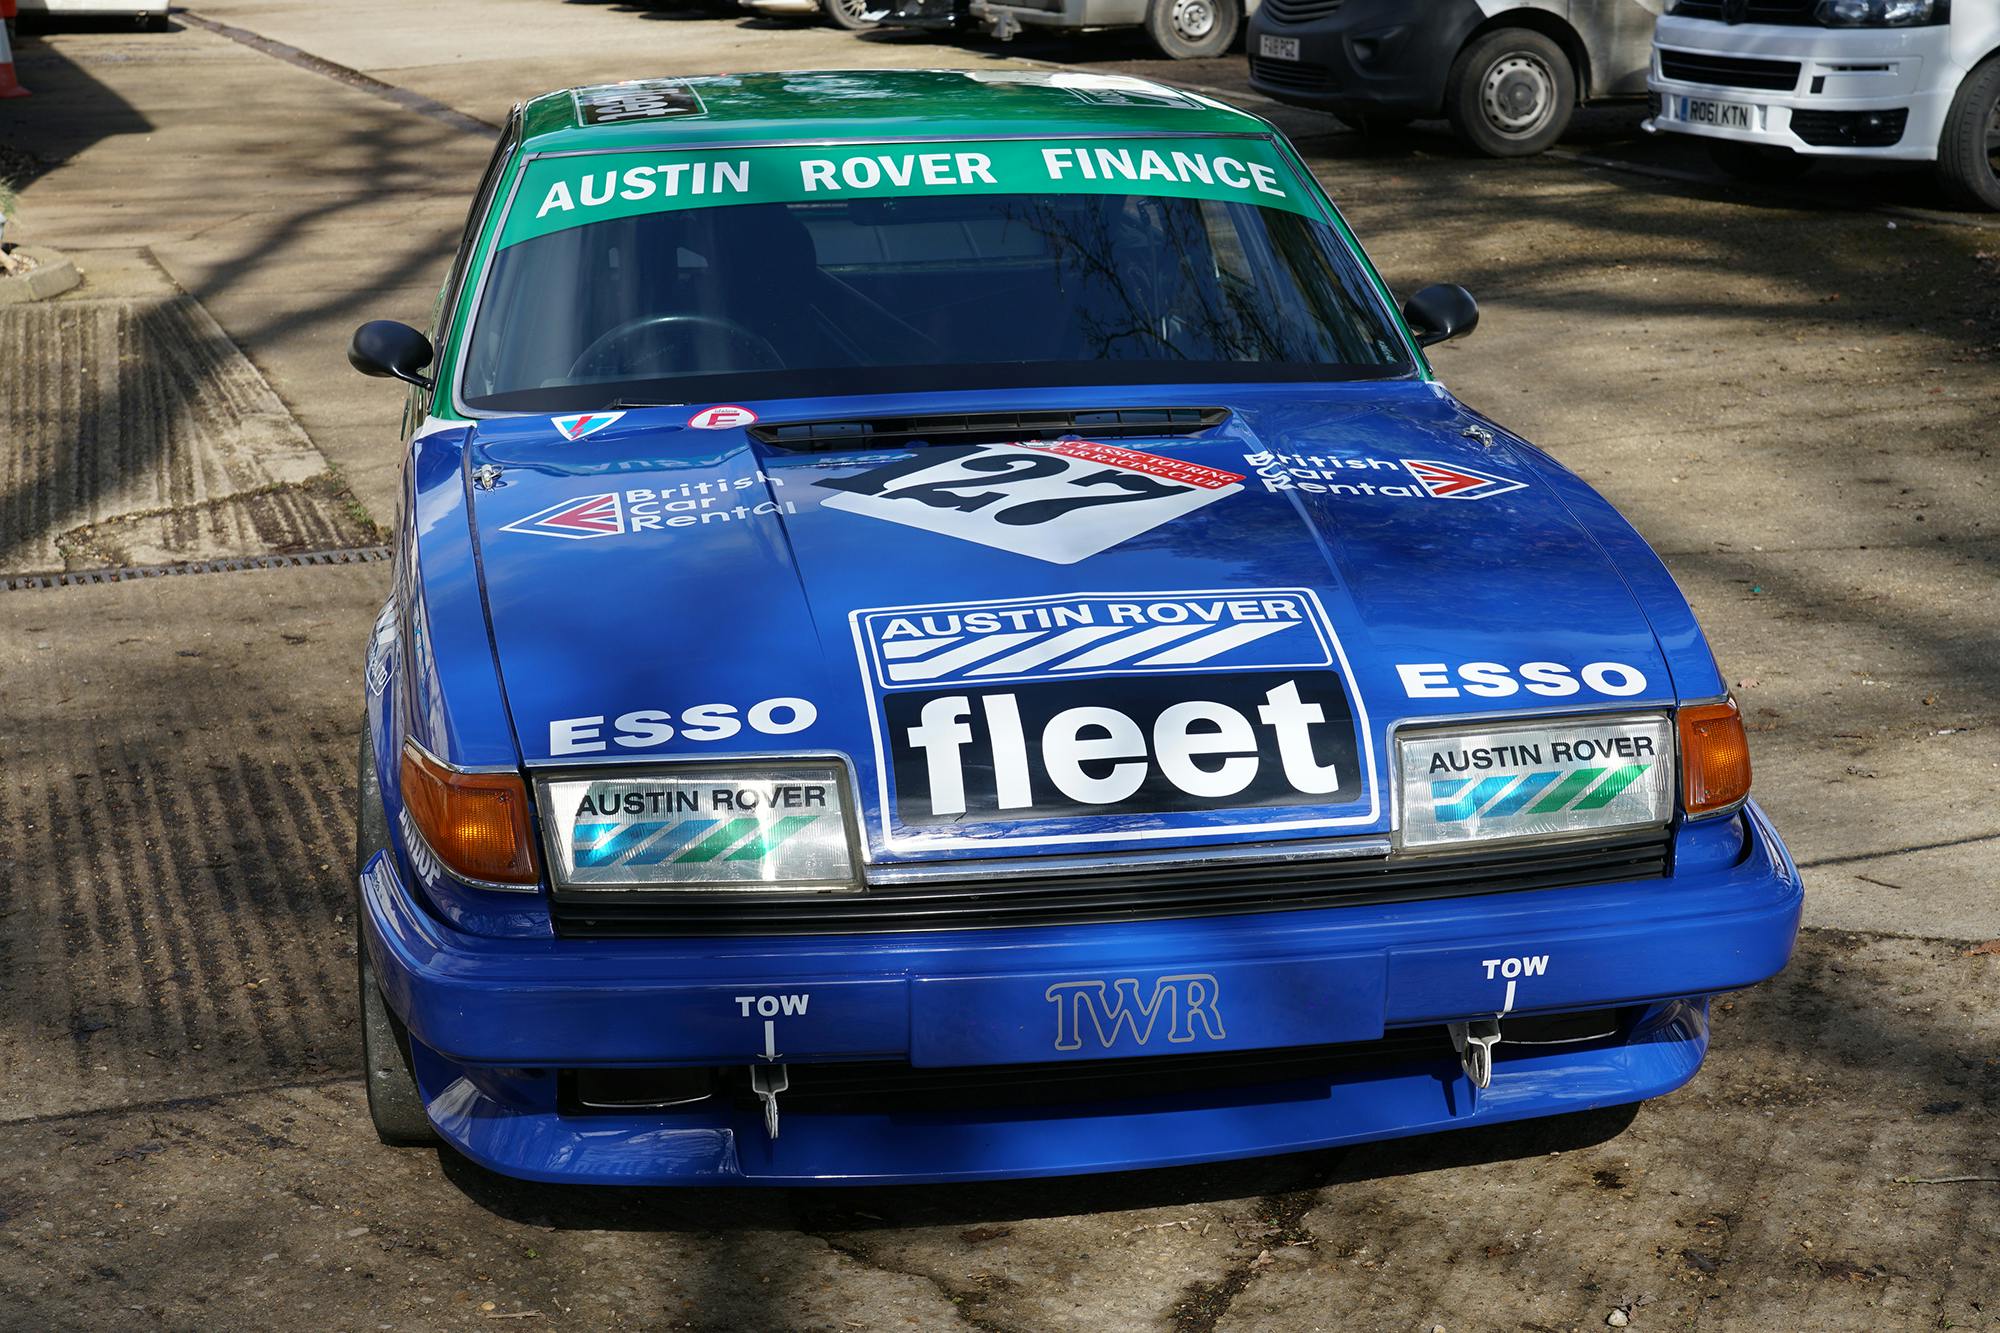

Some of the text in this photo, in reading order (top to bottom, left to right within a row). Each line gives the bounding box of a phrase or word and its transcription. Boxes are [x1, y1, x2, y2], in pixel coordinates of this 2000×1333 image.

[1722, 105, 1748, 126] KTN
[536, 148, 1286, 218] AUSTIN ROVER FINANCE
[1050, 446, 1224, 487] CAR RACING CLUB
[1062, 441, 1147, 460] CLASSIC
[1147, 457, 1238, 481] TOURING
[1243, 450, 1399, 471] British
[1256, 461, 1336, 481] Car
[626, 470, 784, 503] British
[1261, 475, 1425, 498] Rental
[630, 496, 717, 516] Car
[631, 501, 797, 532] Rental
[881, 599, 1302, 639] AUSTIN ROVER
[1395, 662, 1647, 698] ESSO
[550, 697, 817, 756] ESSO
[907, 679, 1340, 815] fleet
[1429, 736, 1655, 774] AUSTIN ROVER
[576, 786, 826, 816] AUSTIN ROVER
[1482, 955, 1549, 980] TOW
[735, 994, 809, 1018] TOW
[1045, 974, 1225, 1051] TWR
